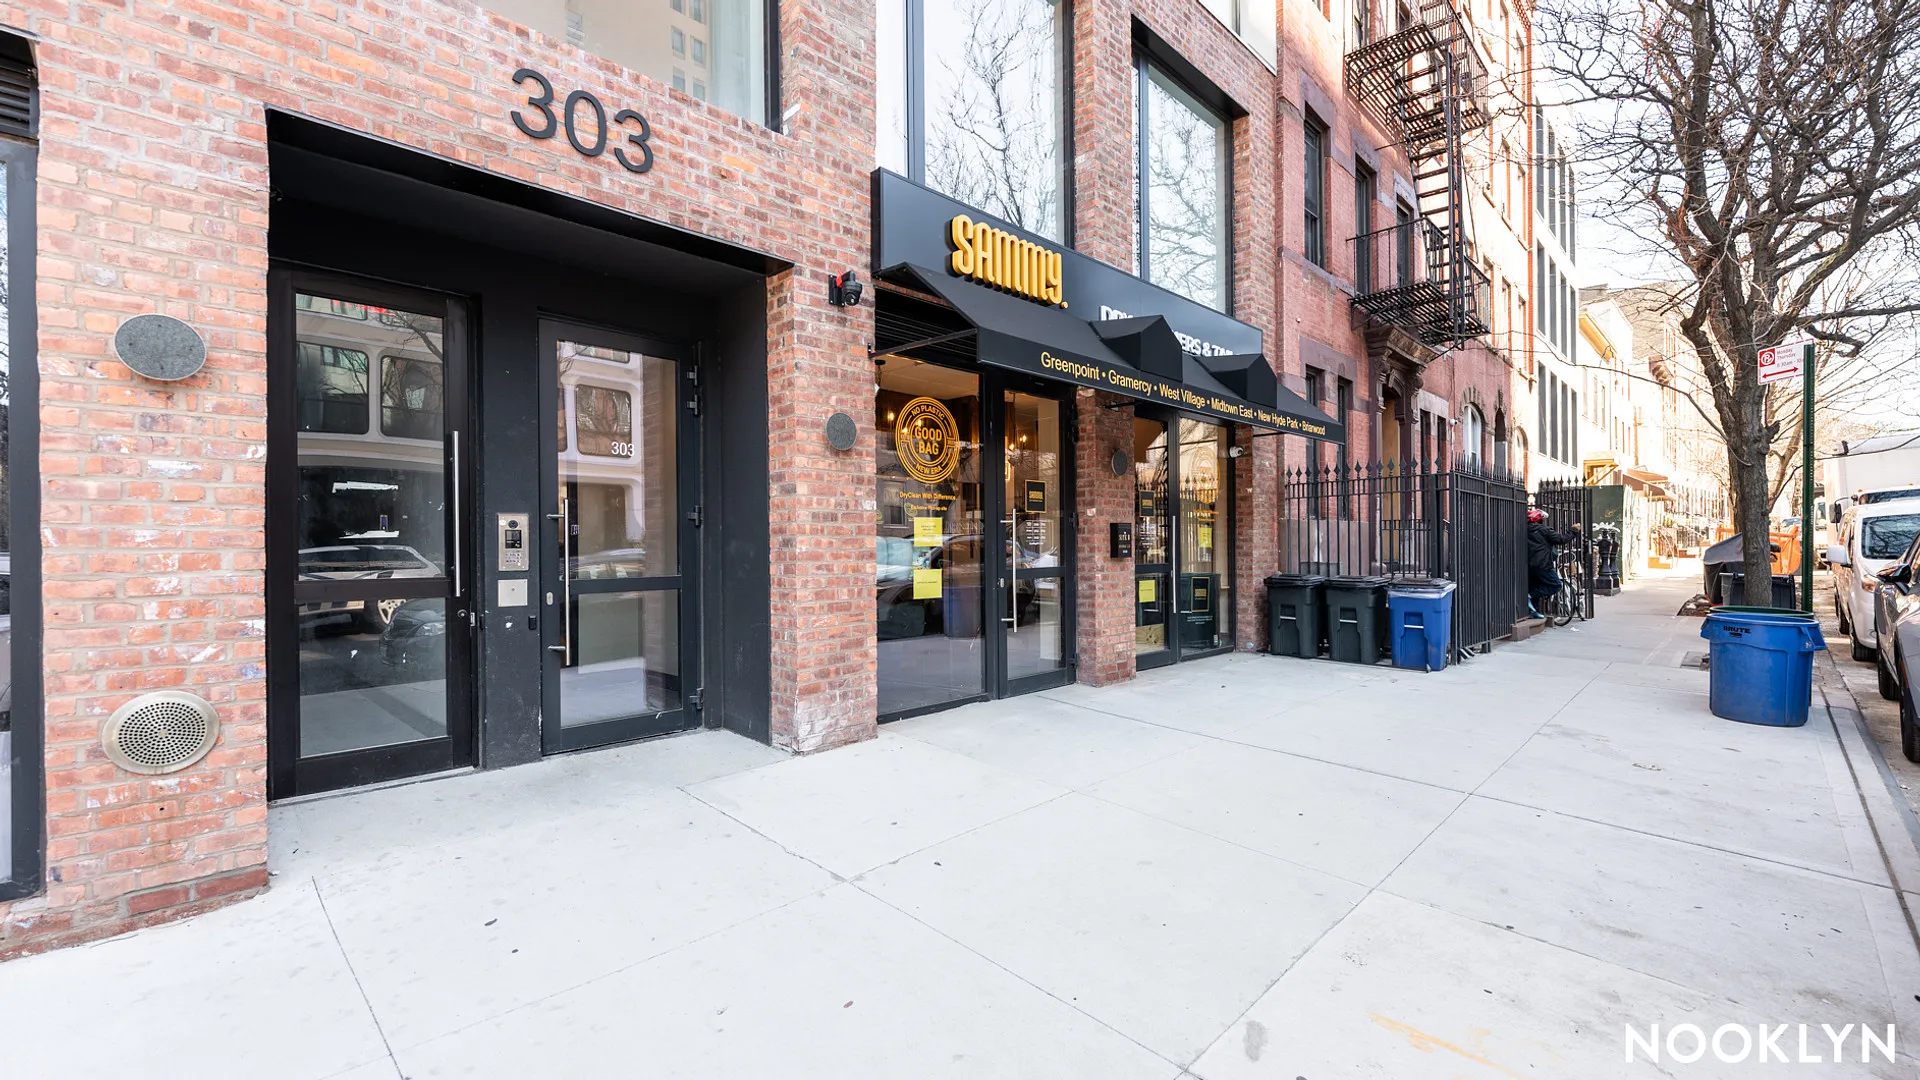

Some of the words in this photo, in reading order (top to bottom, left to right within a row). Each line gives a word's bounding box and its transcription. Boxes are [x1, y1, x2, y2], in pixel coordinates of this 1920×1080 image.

[511, 68, 654, 173] 303
[1041, 351, 1100, 380] Greenpoint
[1108, 369, 1152, 396] Gramercy
[1159, 382, 1180, 401] West
[1181, 388, 1206, 409] Village
[1211, 397, 1239, 416] Midtown
[1239, 404, 1254, 419] East
[1257, 409, 1271, 423] New
[1272, 412, 1286, 427] Hyde
[1286, 416, 1299, 429] Park
[1301, 420, 1326, 436] Briarwood
[911, 407, 921, 417] NO
[921, 405, 945, 420] PLASTIC
[915, 426, 942, 441] GOOD
[611, 442, 635, 457] 303
[918, 441, 939, 455] BAG
[915, 463, 930, 475] NEW
[930, 465, 943, 475] ERA
[1723, 625, 1751, 634] BRUTE
